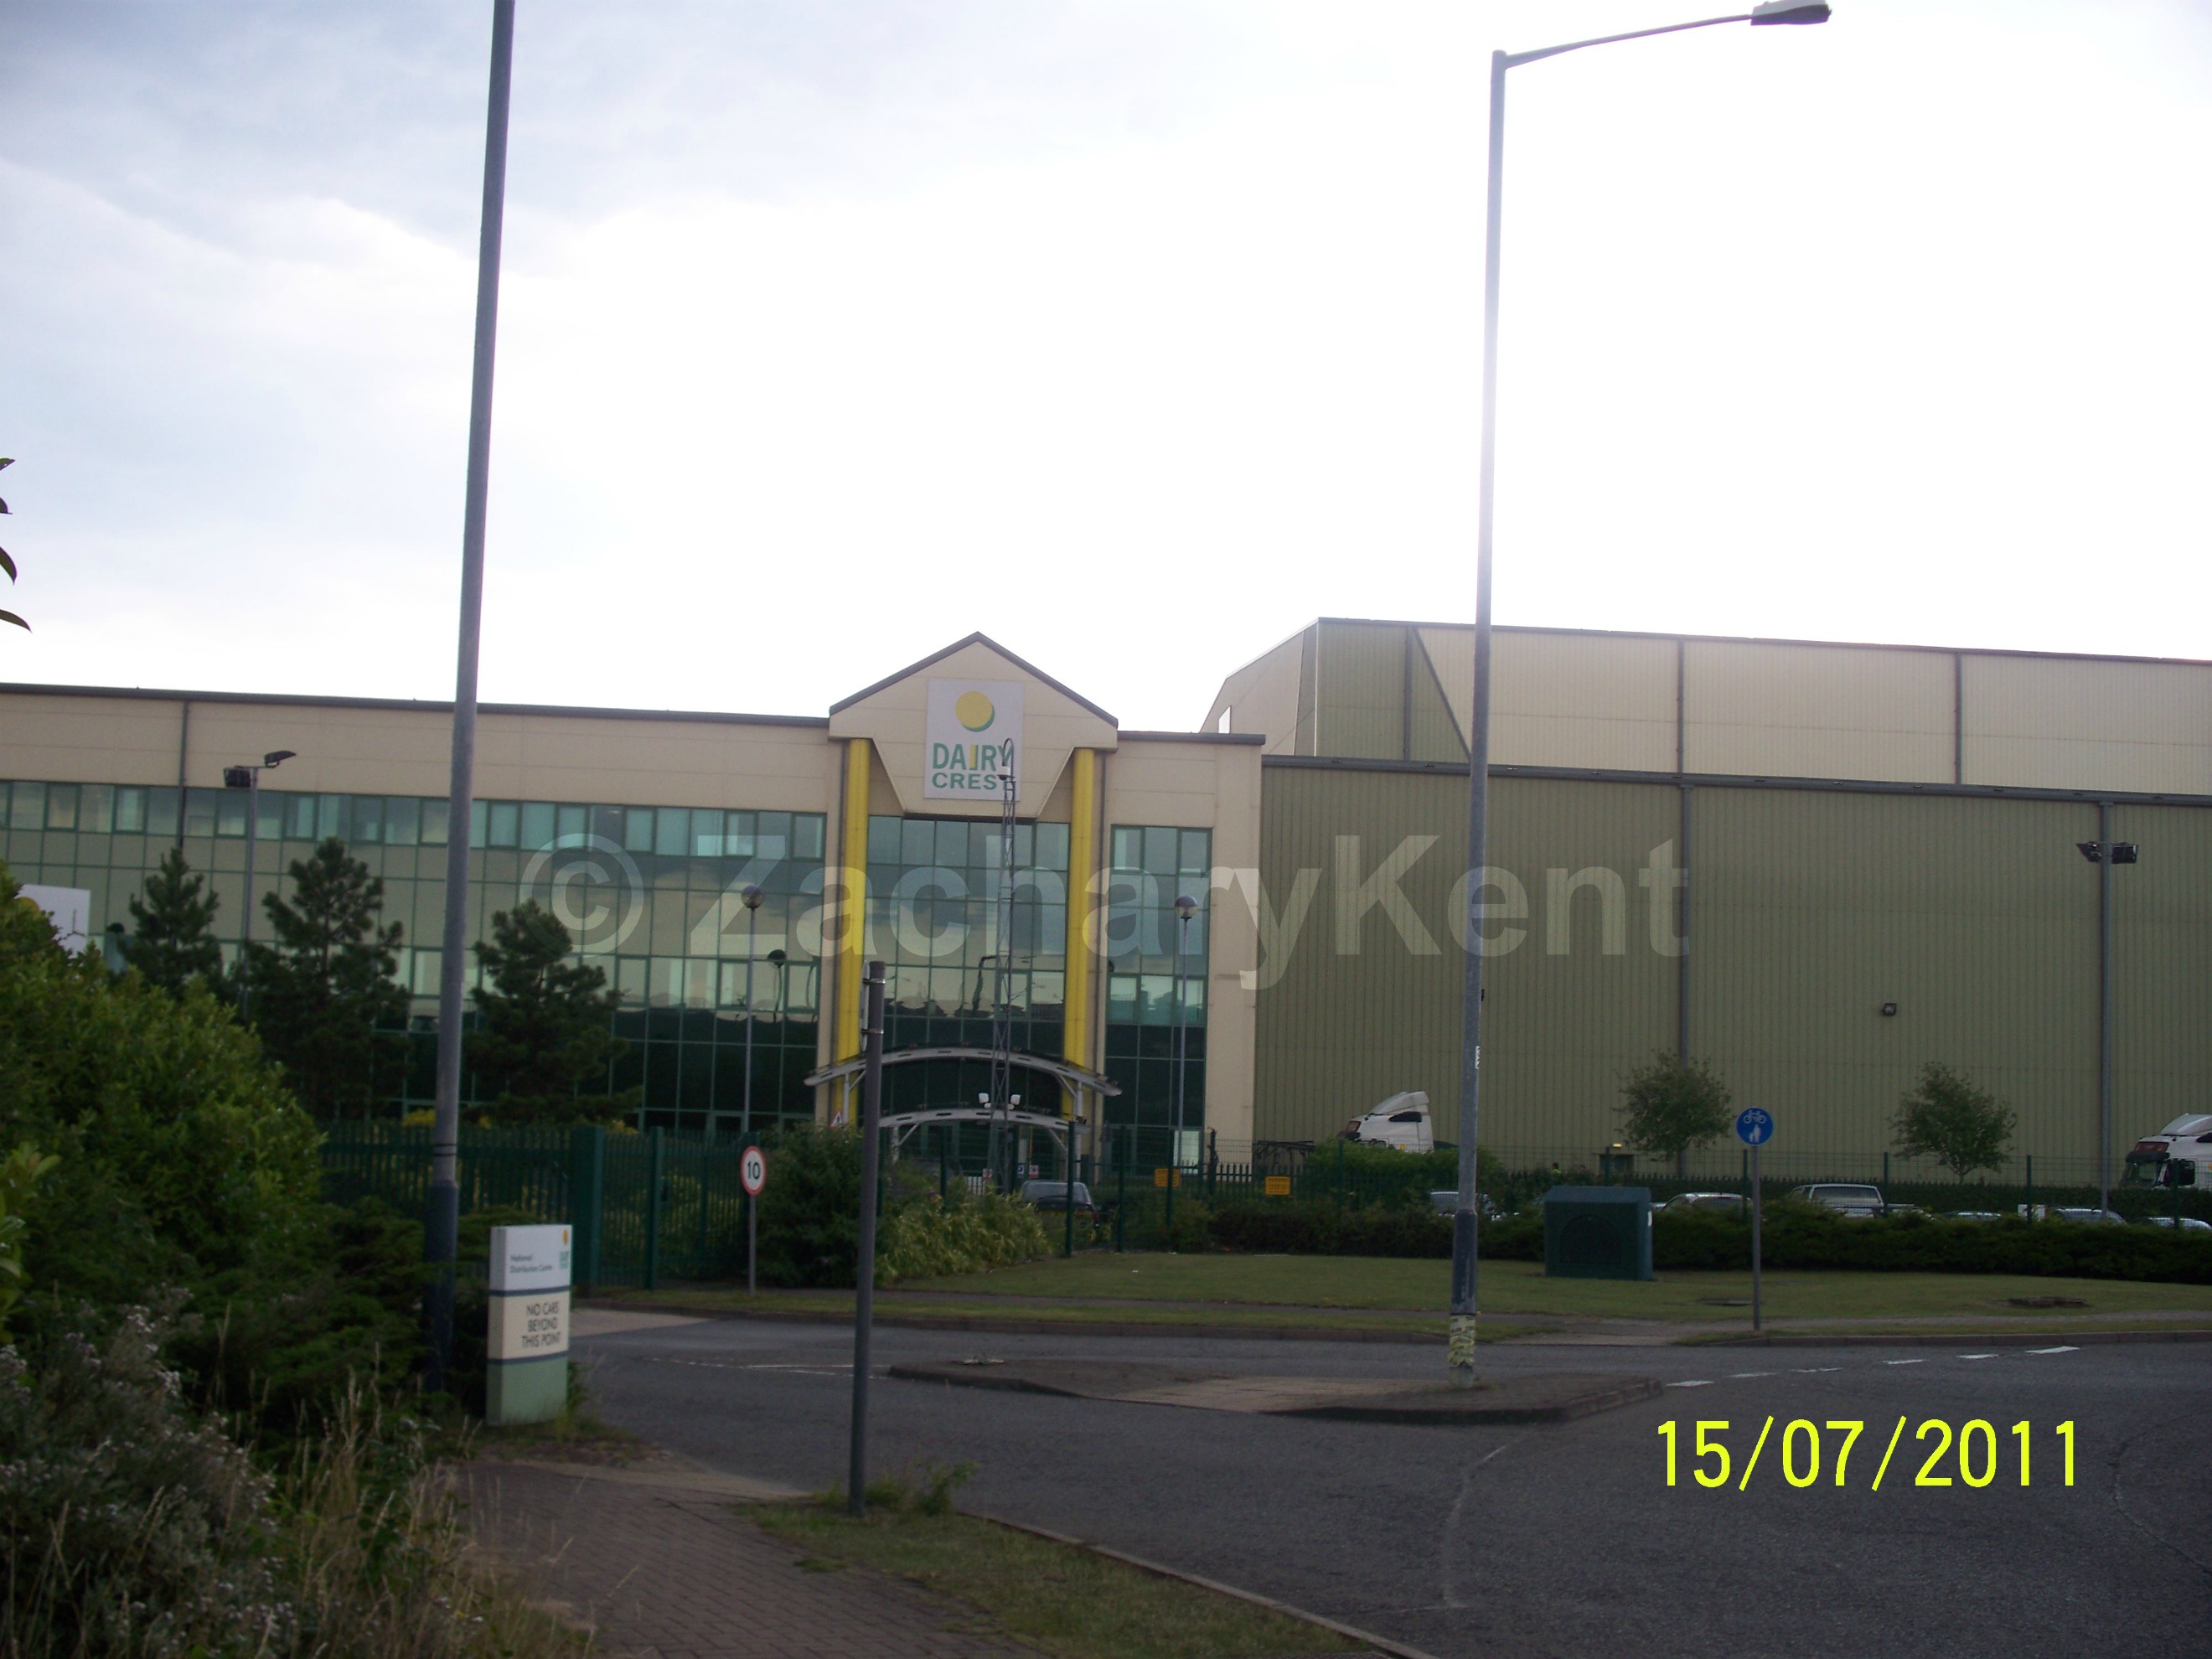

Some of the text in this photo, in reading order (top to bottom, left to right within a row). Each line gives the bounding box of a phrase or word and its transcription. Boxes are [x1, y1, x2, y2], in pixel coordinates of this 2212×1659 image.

[933, 742, 1012, 772] DAIRY
[932, 772, 1009, 790] CRES
[747, 1161, 761, 1180] 10
[527, 1300, 560, 1316] NO CARS
[528, 1317, 558, 1332] BEYOND
[521, 1331, 561, 1348] THIS POINT
